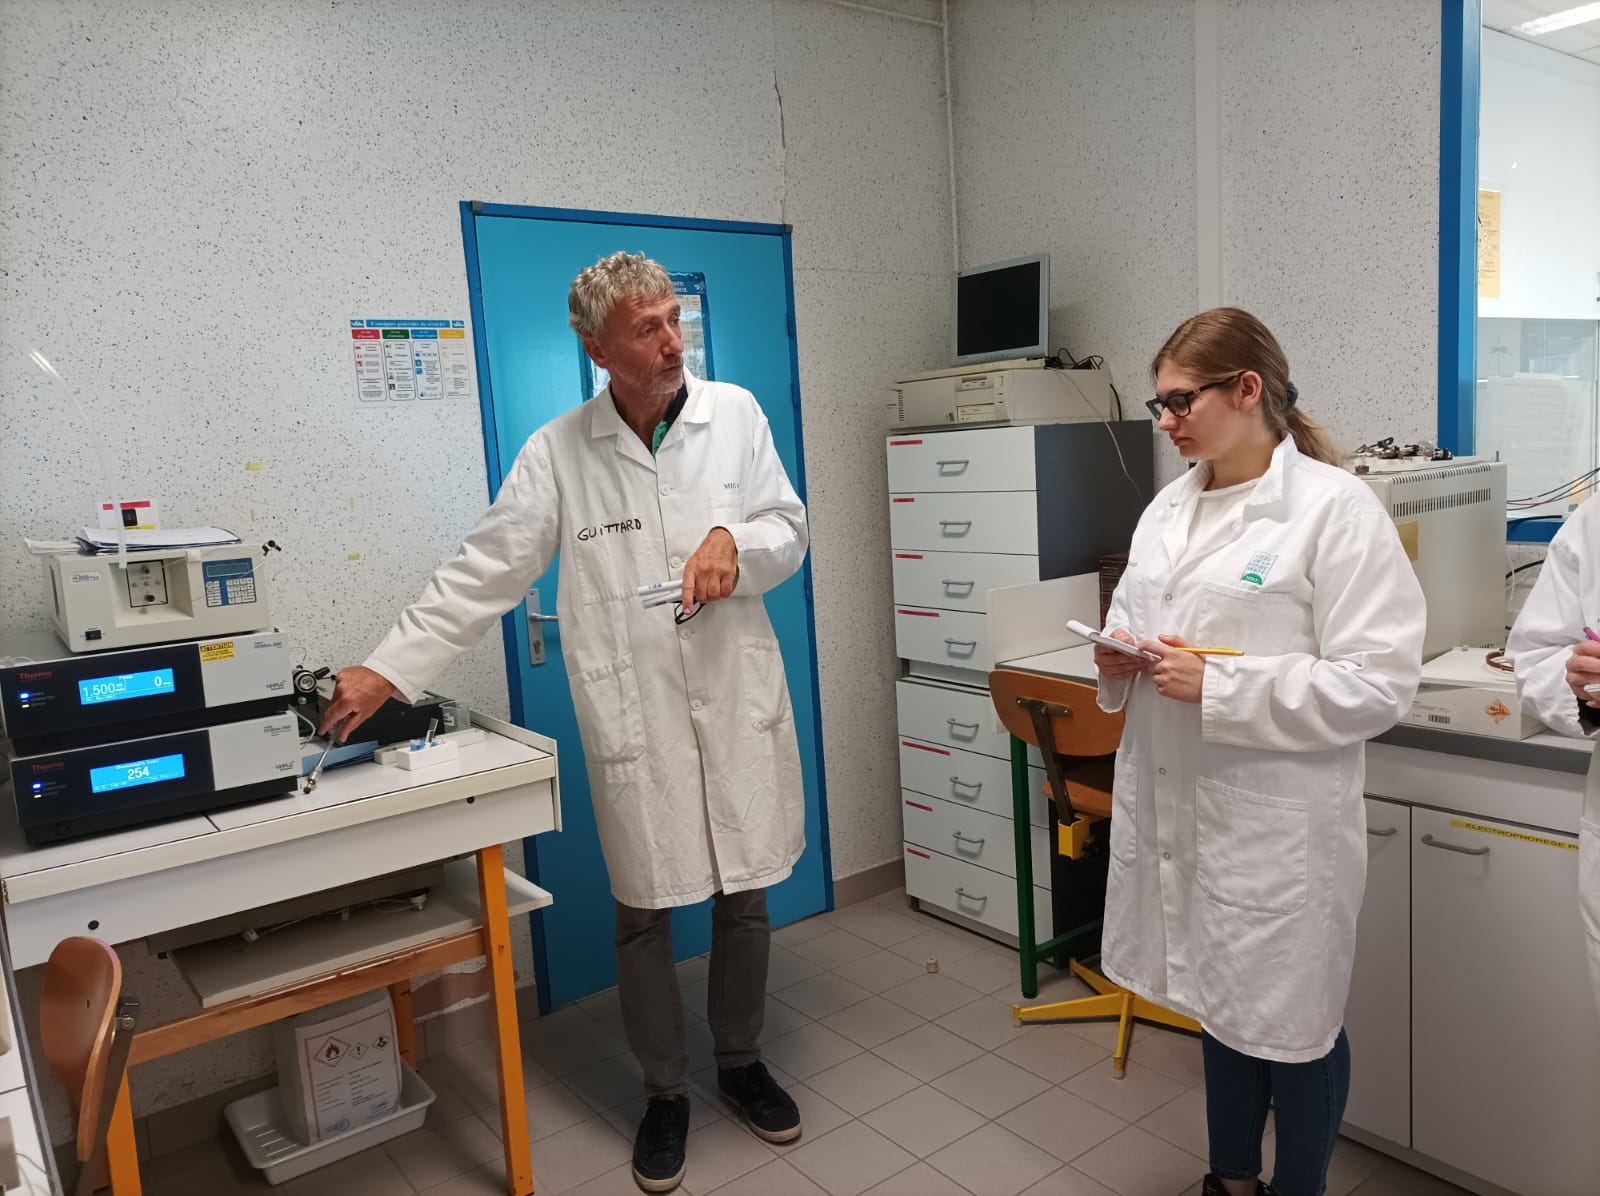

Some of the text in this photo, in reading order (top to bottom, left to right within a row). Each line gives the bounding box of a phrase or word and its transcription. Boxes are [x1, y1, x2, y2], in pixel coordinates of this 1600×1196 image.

[82, 683, 115, 697] 1.500
[154, 675, 163, 687] 0
[127, 766, 150, 780] 254
